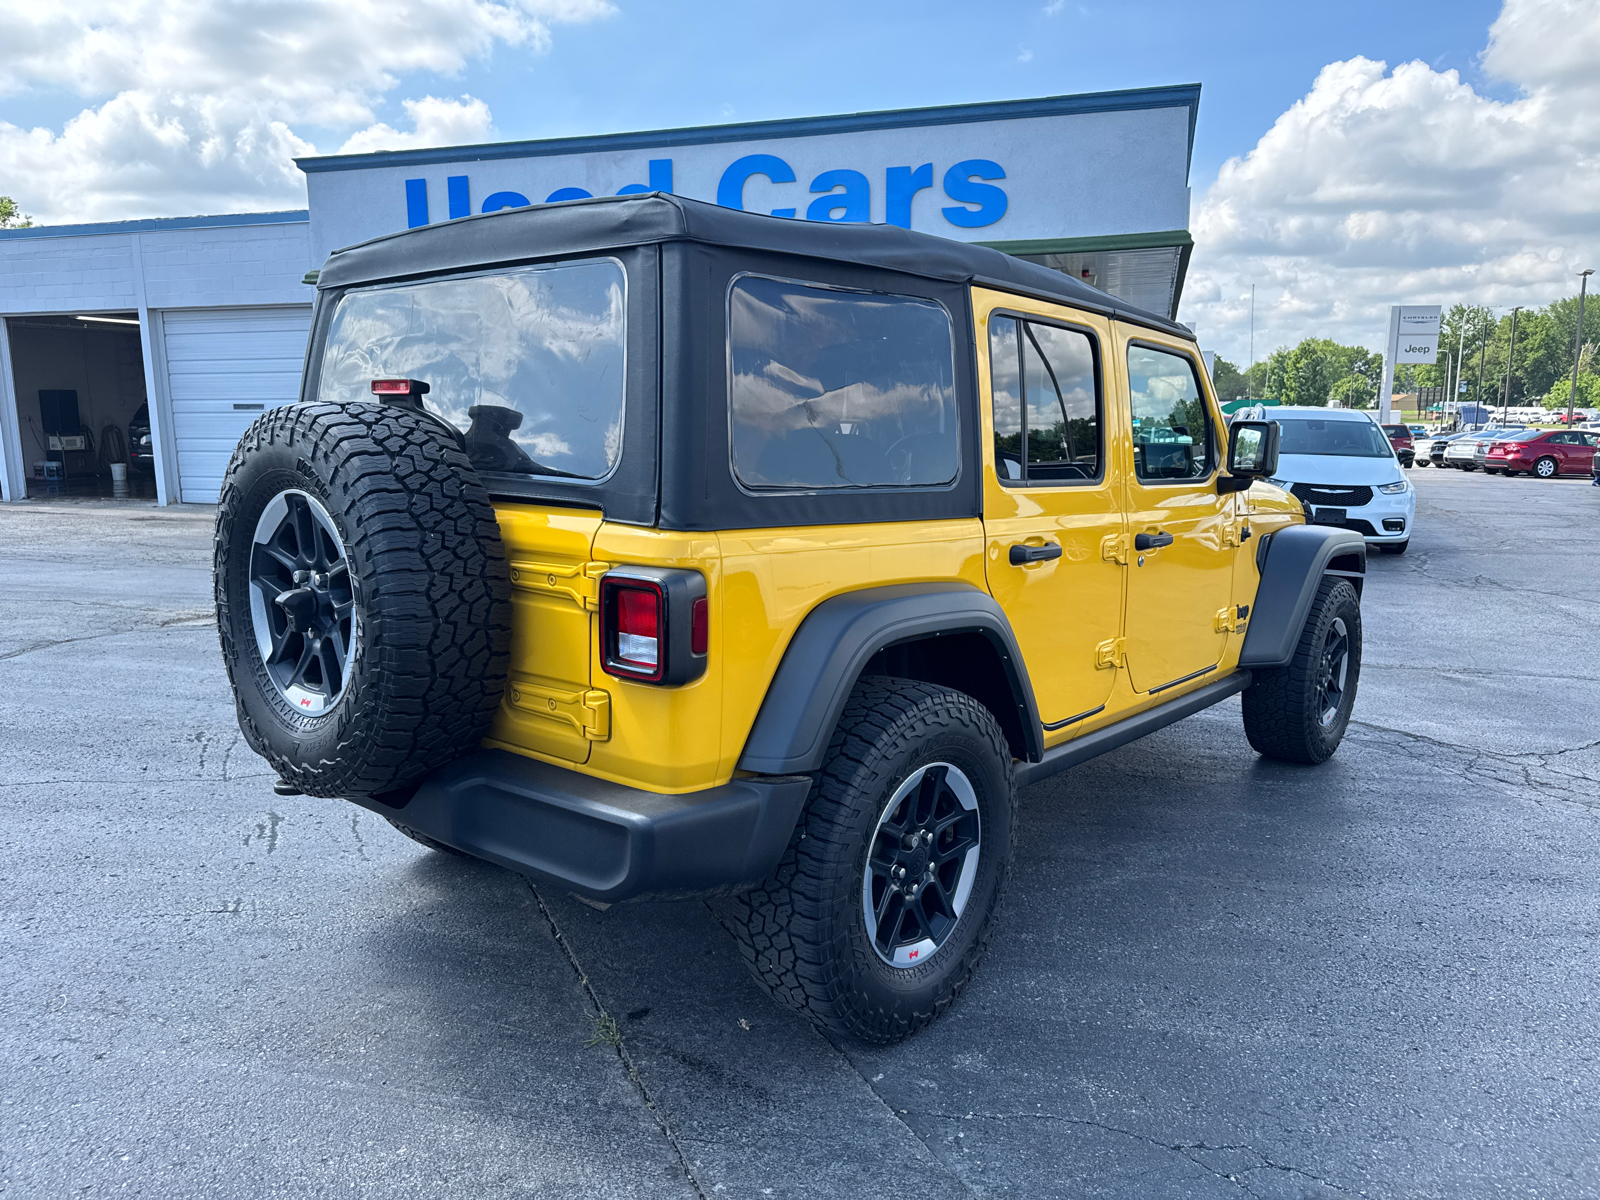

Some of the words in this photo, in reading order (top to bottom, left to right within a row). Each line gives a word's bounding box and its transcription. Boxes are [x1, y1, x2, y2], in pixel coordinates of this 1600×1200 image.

[405, 158, 674, 229] Ud
[716, 154, 1008, 229] Cars
[1404, 344, 1430, 355] Jeep
